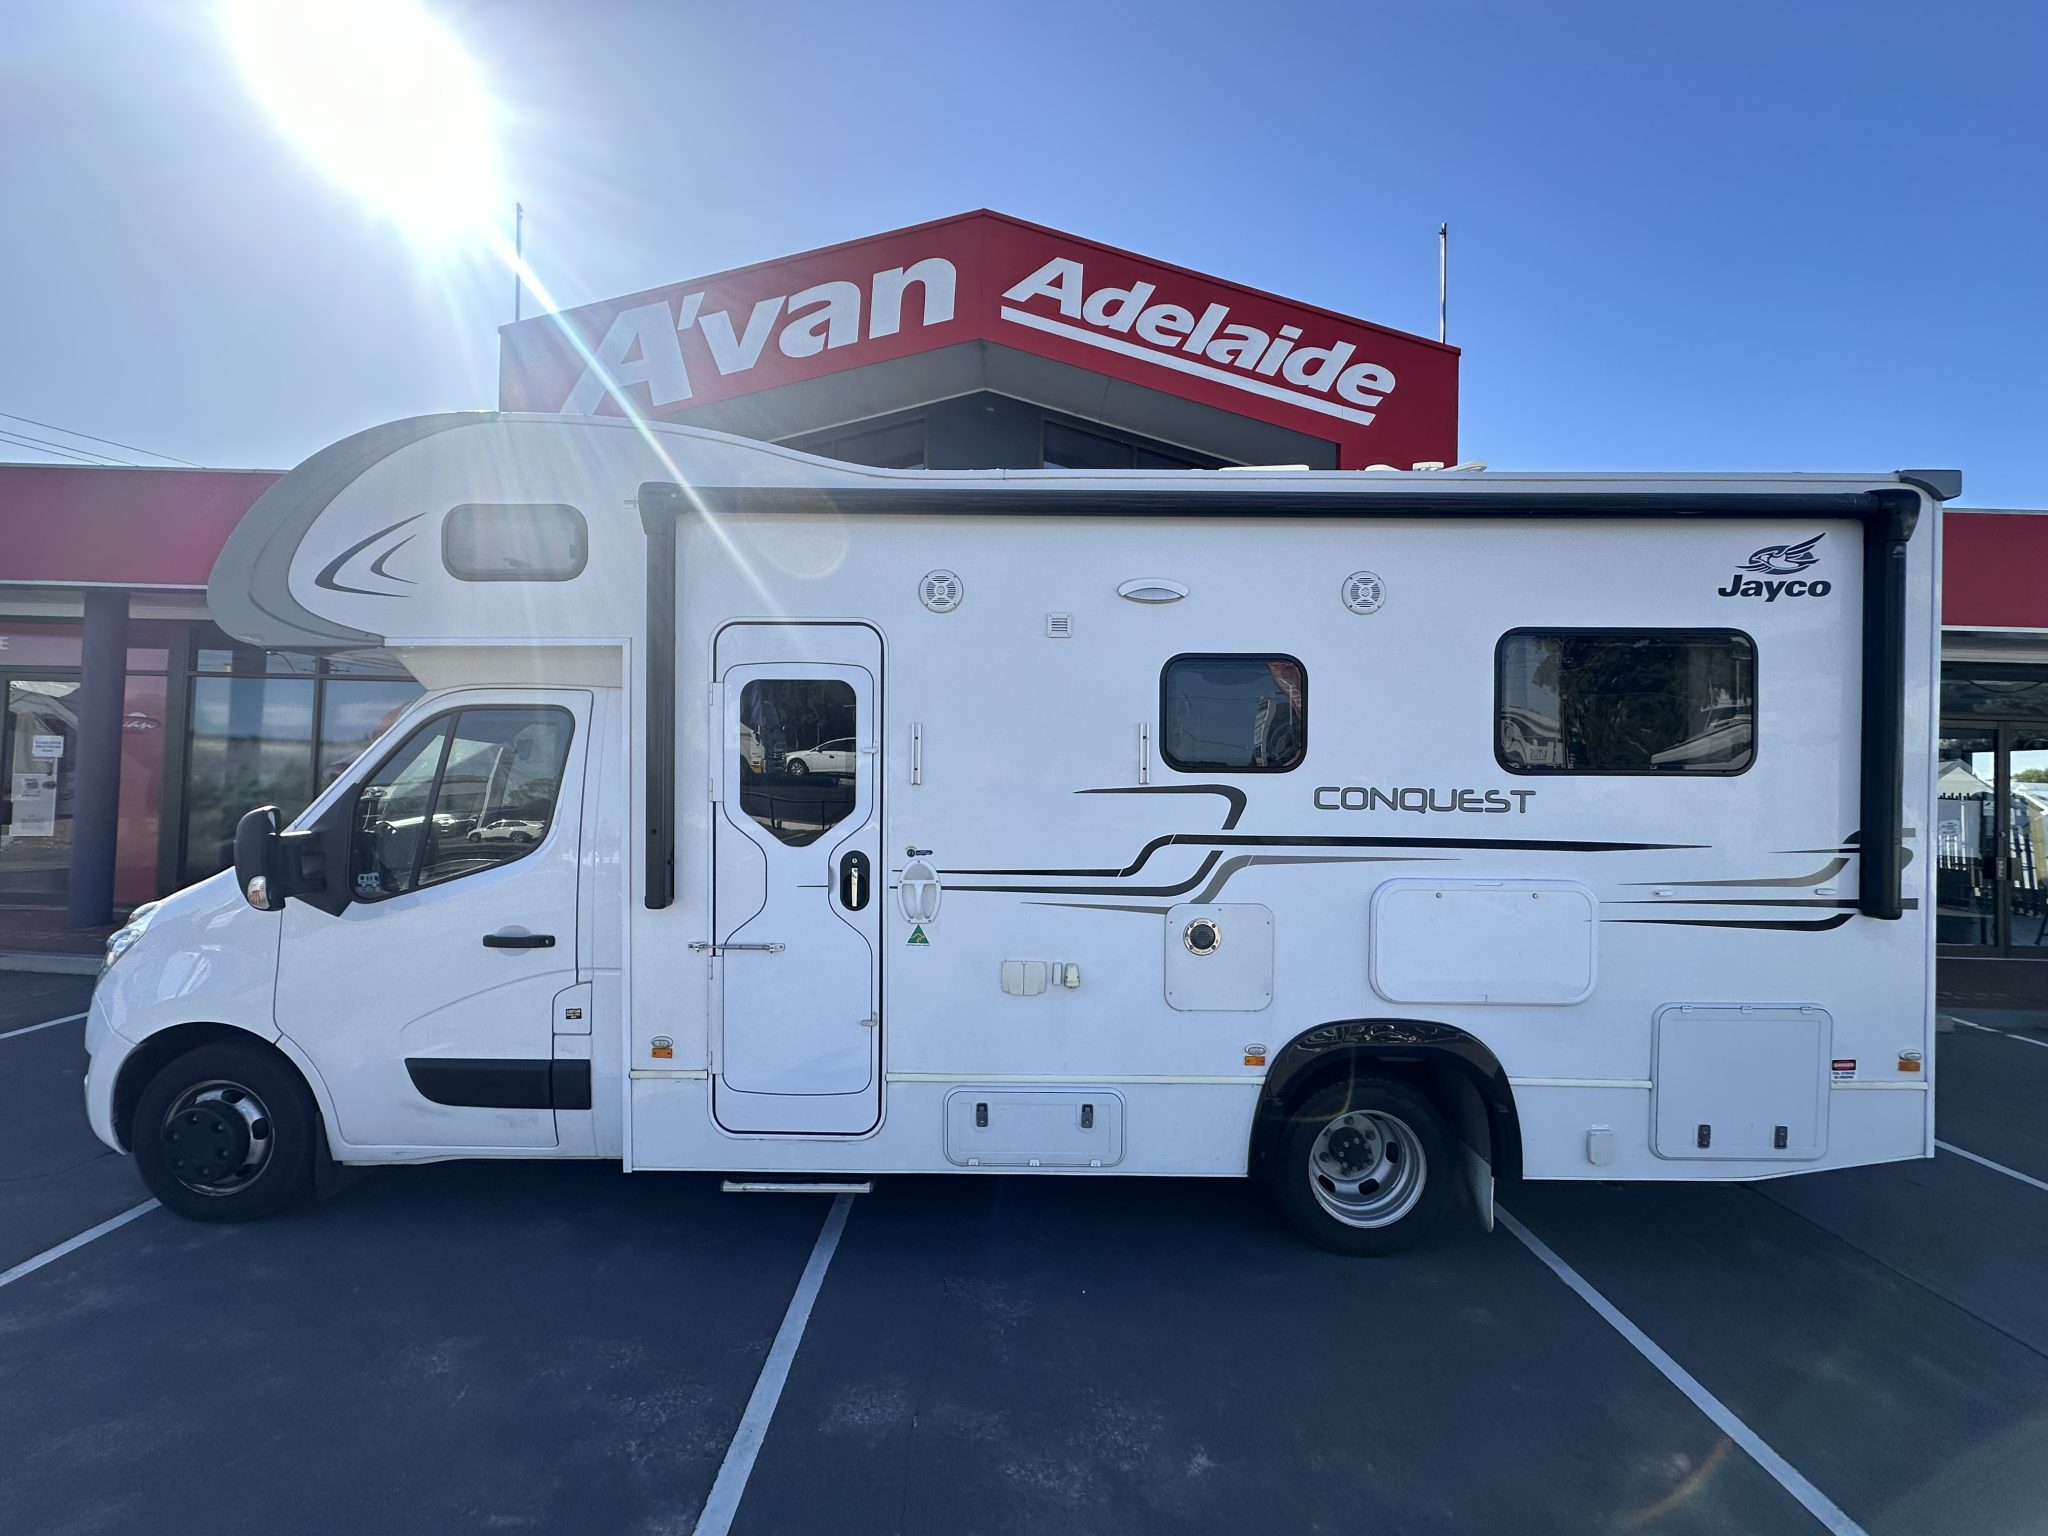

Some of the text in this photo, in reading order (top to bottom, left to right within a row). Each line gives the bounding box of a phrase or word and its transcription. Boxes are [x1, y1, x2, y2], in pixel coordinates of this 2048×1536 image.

[559, 257, 1395, 414] A'van Adelaide
[1718, 574, 1831, 602] Jayco
[1313, 786, 1536, 814] CONQUEST
